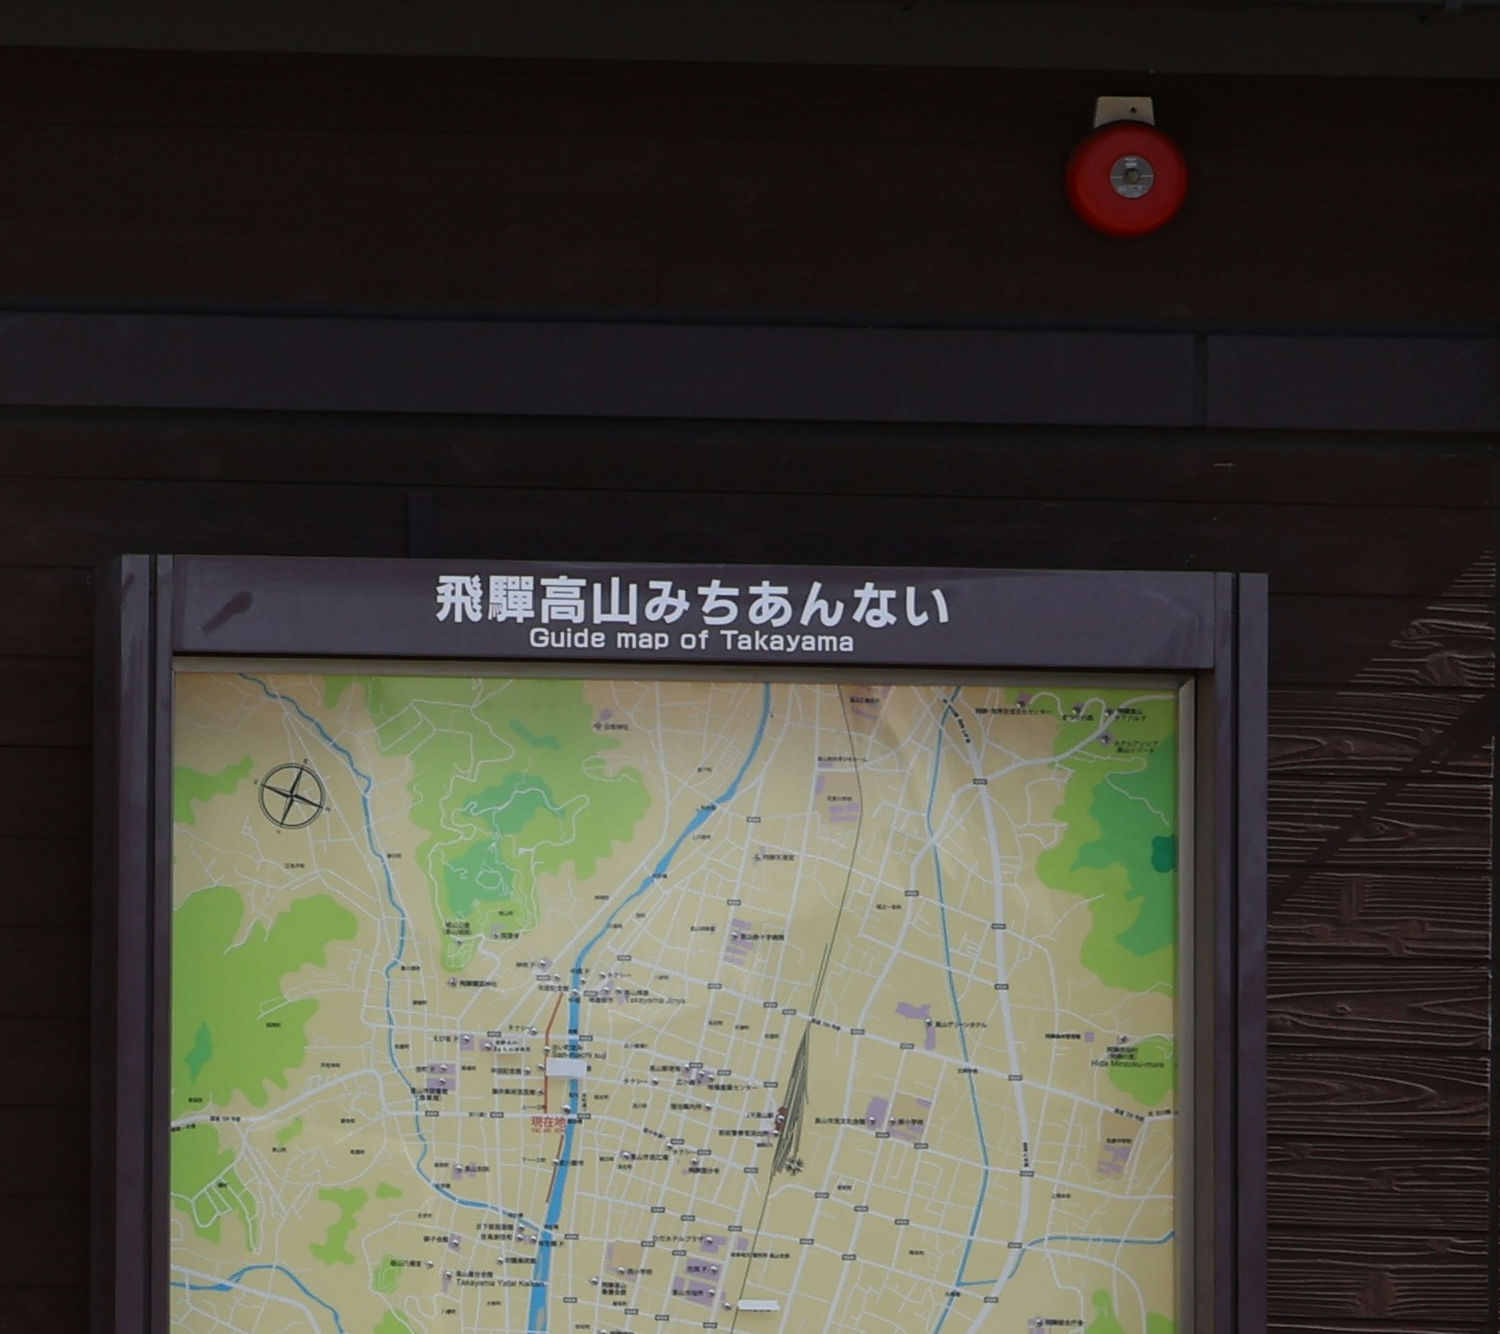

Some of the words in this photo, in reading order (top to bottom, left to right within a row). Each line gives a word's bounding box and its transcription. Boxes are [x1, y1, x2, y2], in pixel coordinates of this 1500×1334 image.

[529, 627, 606, 649] Guide
[617, 632, 668, 651] map
[680, 629, 709, 650] of
[719, 630, 855, 653] Takayama
[531, 1116, 566, 1128] 現在地
